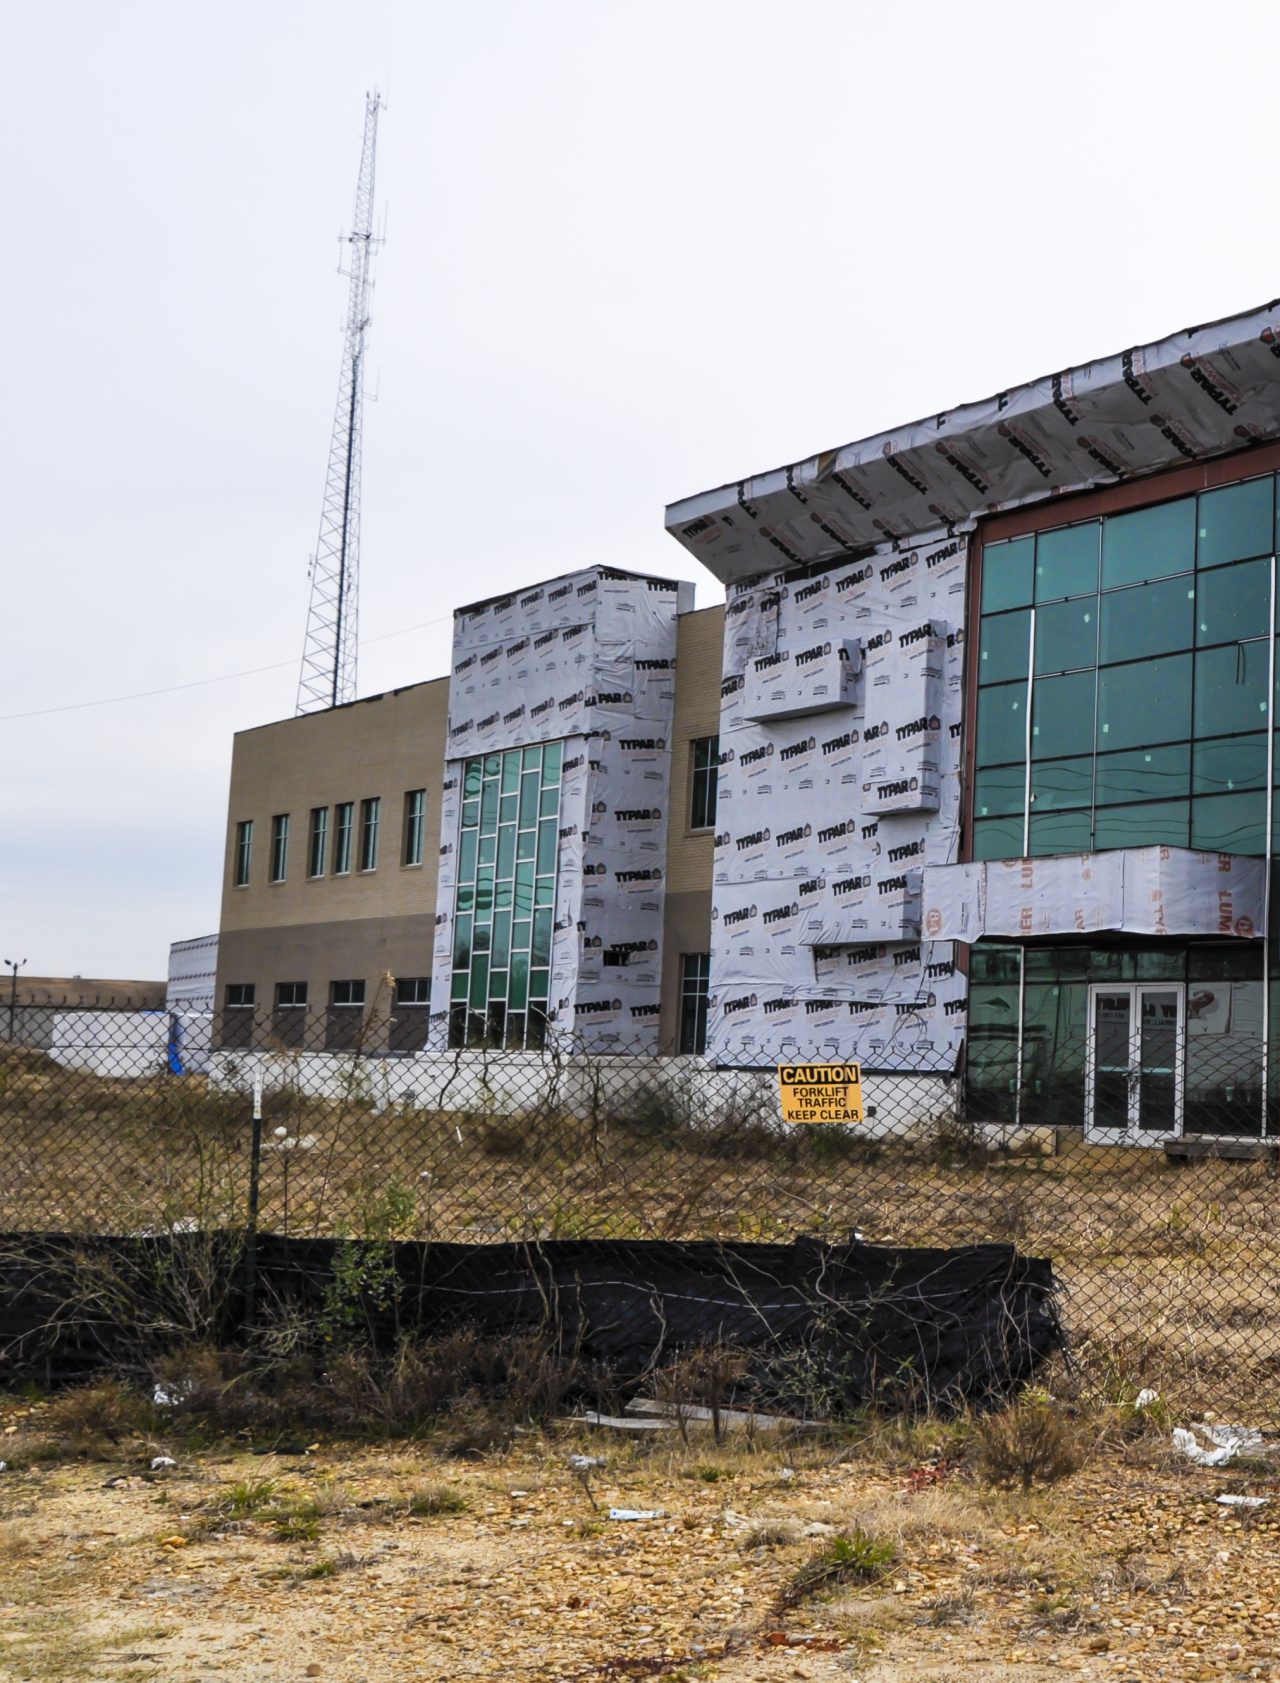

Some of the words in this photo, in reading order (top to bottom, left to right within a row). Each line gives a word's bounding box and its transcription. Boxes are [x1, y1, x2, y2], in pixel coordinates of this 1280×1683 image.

[1190, 368, 1238, 416] TYPAR
[925, 543, 957, 568] TYPAR
[880, 557, 909, 582] TYPAR
[836, 570, 864, 593] TYPAR
[794, 581, 822, 604] TYPAR
[899, 623, 932, 648] TYPAR
[634, 659, 669, 671] TYPAR
[754, 652, 782, 672] TYPAR
[795, 644, 823, 667] TYPAR
[896, 717, 928, 741] TYPAR
[619, 739, 655, 750] TYPAR
[780, 740, 807, 761] TYPAR
[822, 734, 850, 756] TYPAR
[740, 746, 766, 767] TYPAR
[877, 780, 909, 800] TYPAR
[614, 810, 651, 821] TYPAR
[736, 830, 763, 851] TYPAR
[776, 827, 803, 847] TYPAR
[817, 823, 845, 843] TYPAR
[888, 841, 919, 863] TYPAR
[614, 871, 651, 882] TYPAR
[832, 876, 862, 897] TYPAR
[723, 907, 749, 926] TYPAR
[763, 904, 791, 925] TYPAR
[847, 947, 876, 966] TYPAR
[574, 1001, 611, 1013] TYPAR
[723, 996, 750, 1015] TYPAR
[783, 1067, 857, 1083] CAUTION
[793, 1087, 848, 1097] FORKLIFT
[797, 1097, 846, 1108] TRAFFIC
[788, 1110, 817, 1120] KEEP
[820, 1109, 859, 1120] CLEAR
